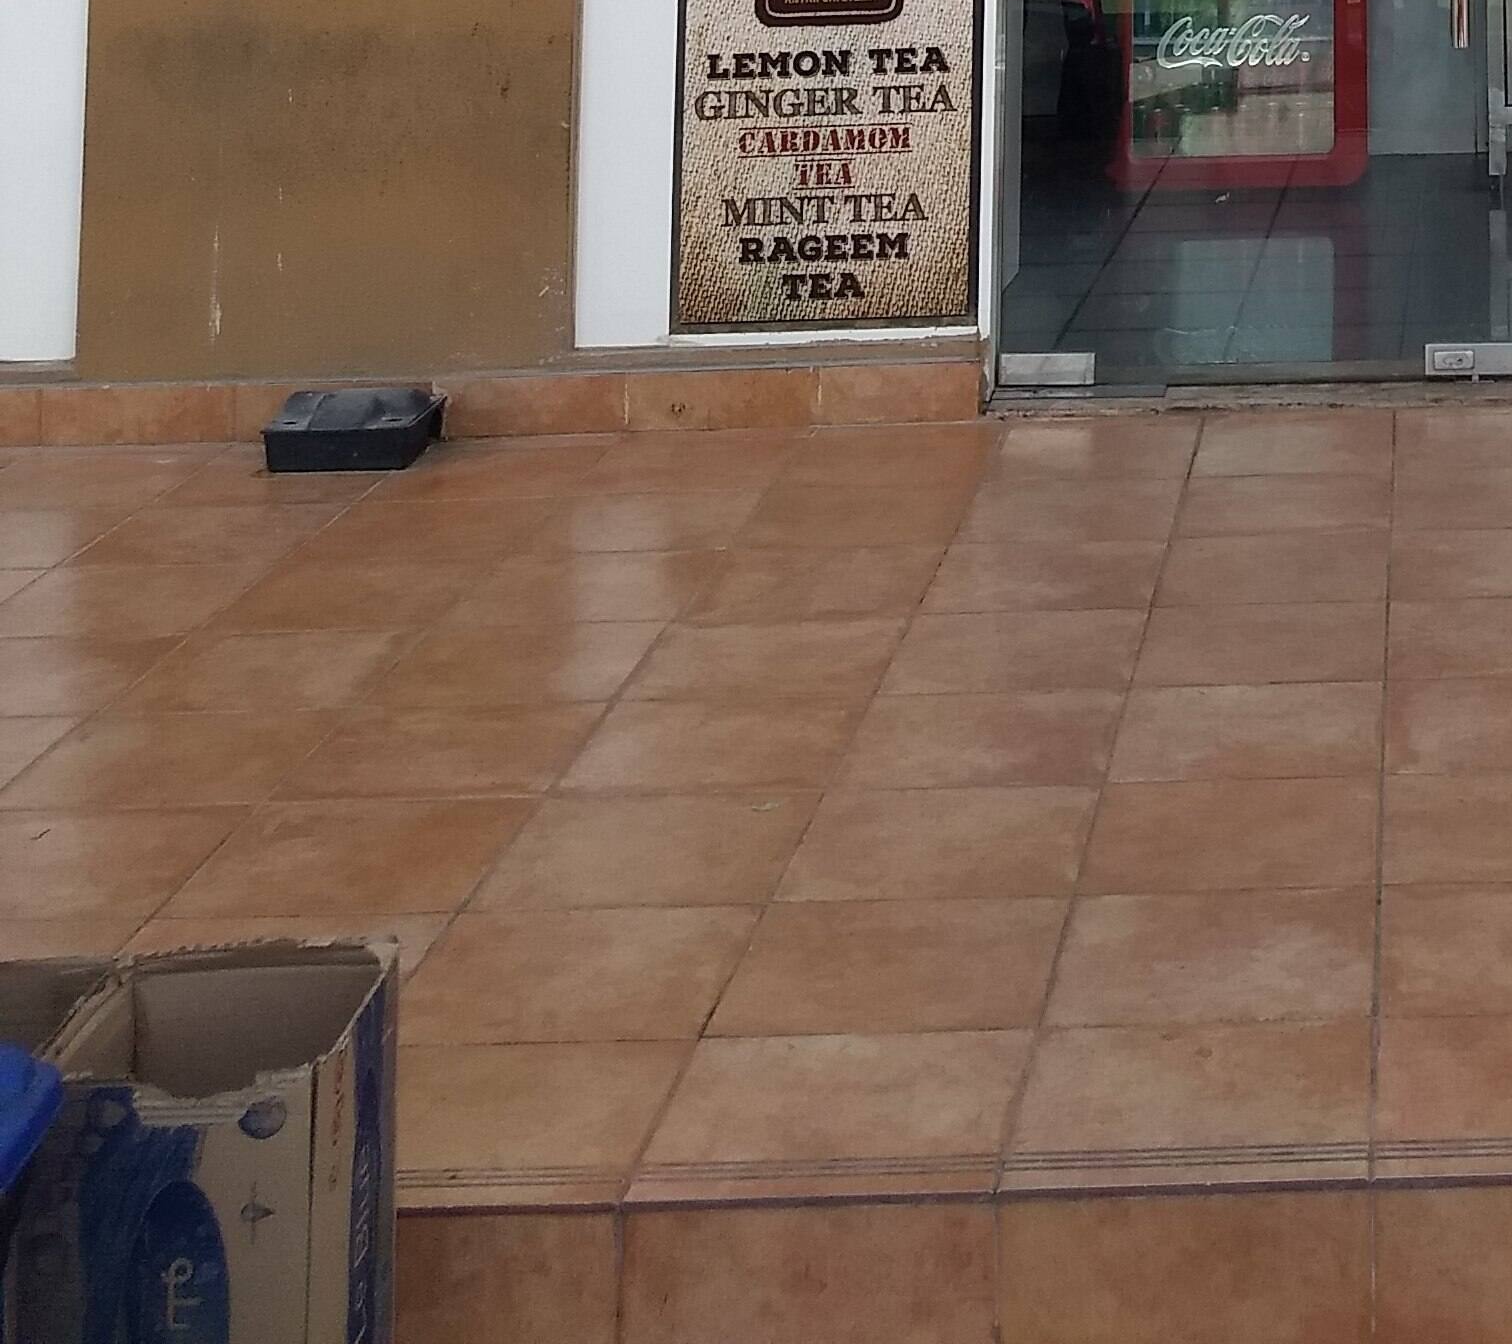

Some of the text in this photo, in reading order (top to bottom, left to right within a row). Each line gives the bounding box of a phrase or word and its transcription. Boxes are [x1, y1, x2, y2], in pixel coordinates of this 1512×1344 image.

[1157, 14, 1310, 69] Coca-Cola
[706, 47, 950, 79] LEMON TEA
[694, 84, 958, 120] GINGER TEA
[738, 127, 911, 154] CARDAMOM
[796, 162, 853, 186] TEA
[721, 193, 929, 227] MINT TEA
[738, 232, 910, 264] RAGEEM
[783, 272, 866, 300] TEA
